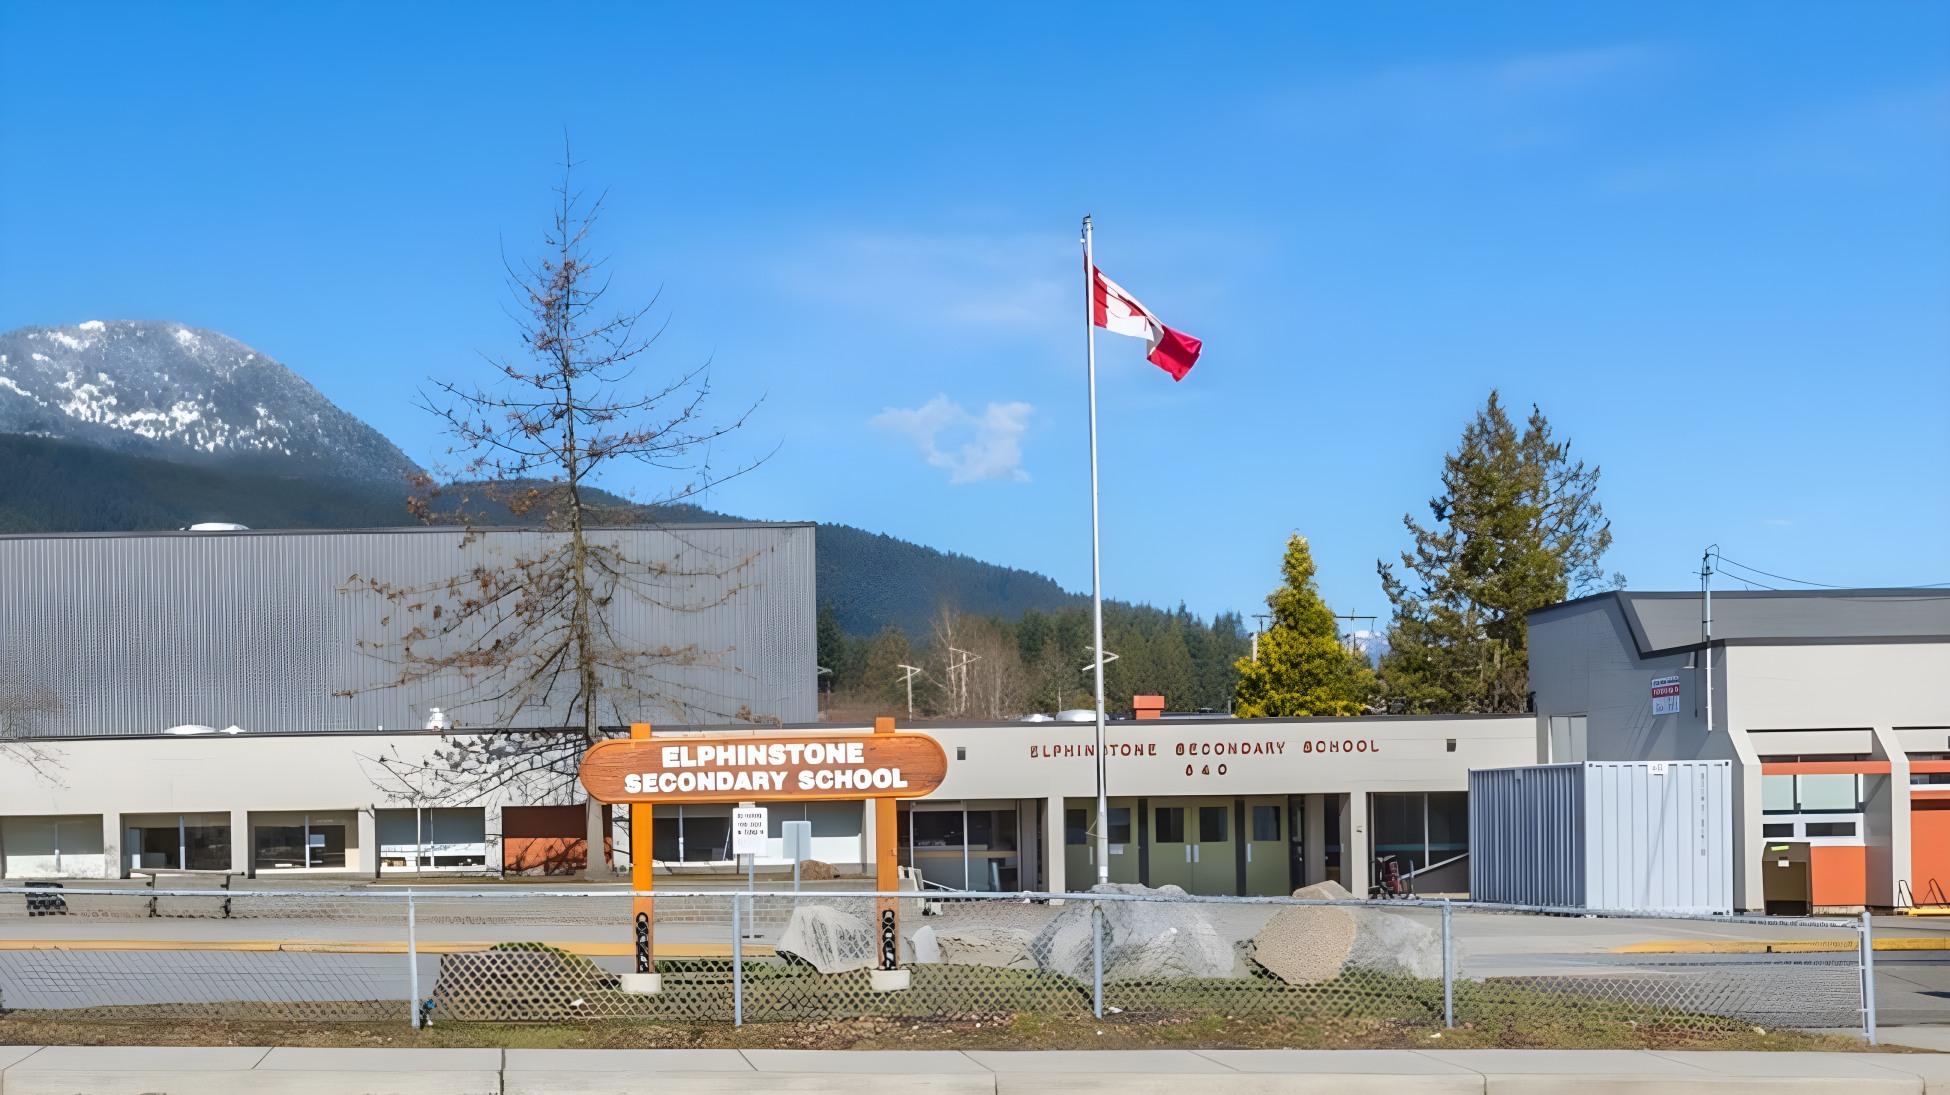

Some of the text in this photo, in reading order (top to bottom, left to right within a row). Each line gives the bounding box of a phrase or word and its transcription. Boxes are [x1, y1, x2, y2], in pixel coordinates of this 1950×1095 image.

[661, 743, 864, 768] ELPHINSTONE
[1030, 743, 1157, 758] LPHINTONE
[624, 768, 908, 794] SECONDARY SCHOOL
